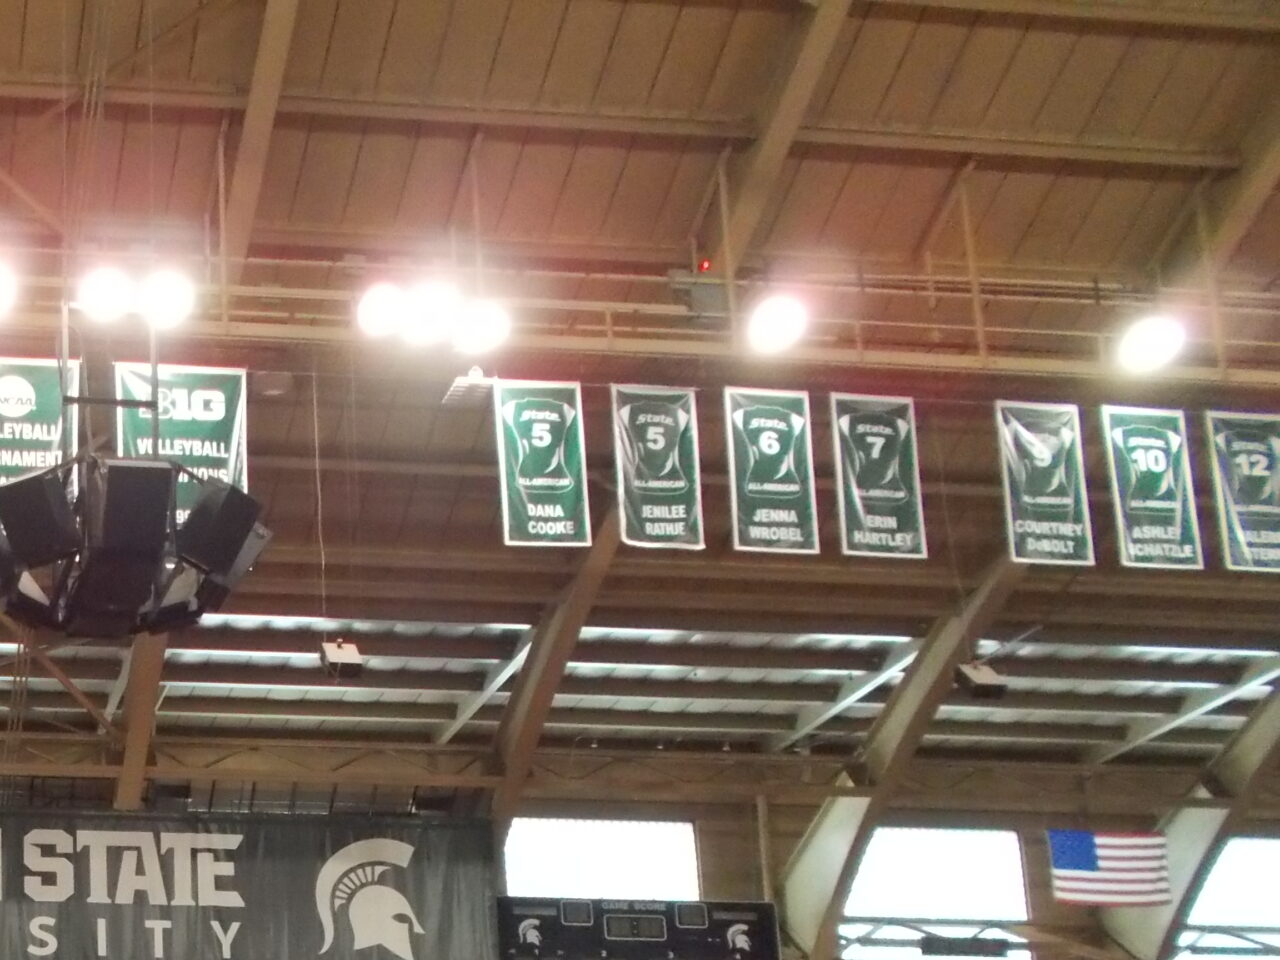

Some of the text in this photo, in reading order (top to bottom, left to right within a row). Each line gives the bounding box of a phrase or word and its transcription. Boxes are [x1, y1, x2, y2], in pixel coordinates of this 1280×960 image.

[531, 423, 552, 447] 5
[646, 427, 665, 450] 5
[758, 430, 781, 455] 6
[865, 436, 886, 459] 7
[1130, 448, 1167, 473] 10
[1235, 453, 1271, 476] 12
[527, 504, 564, 517] DANA
[753, 509, 799, 523] JENNA
[528, 521, 574, 535] COOKE
[866, 515, 897, 528] ERIN
[1015, 519, 1083, 536] COURTNEY
[749, 526, 804, 542] WROBEL
[853, 531, 914, 546] HARTLEY
[23, 828, 246, 908] STATE
